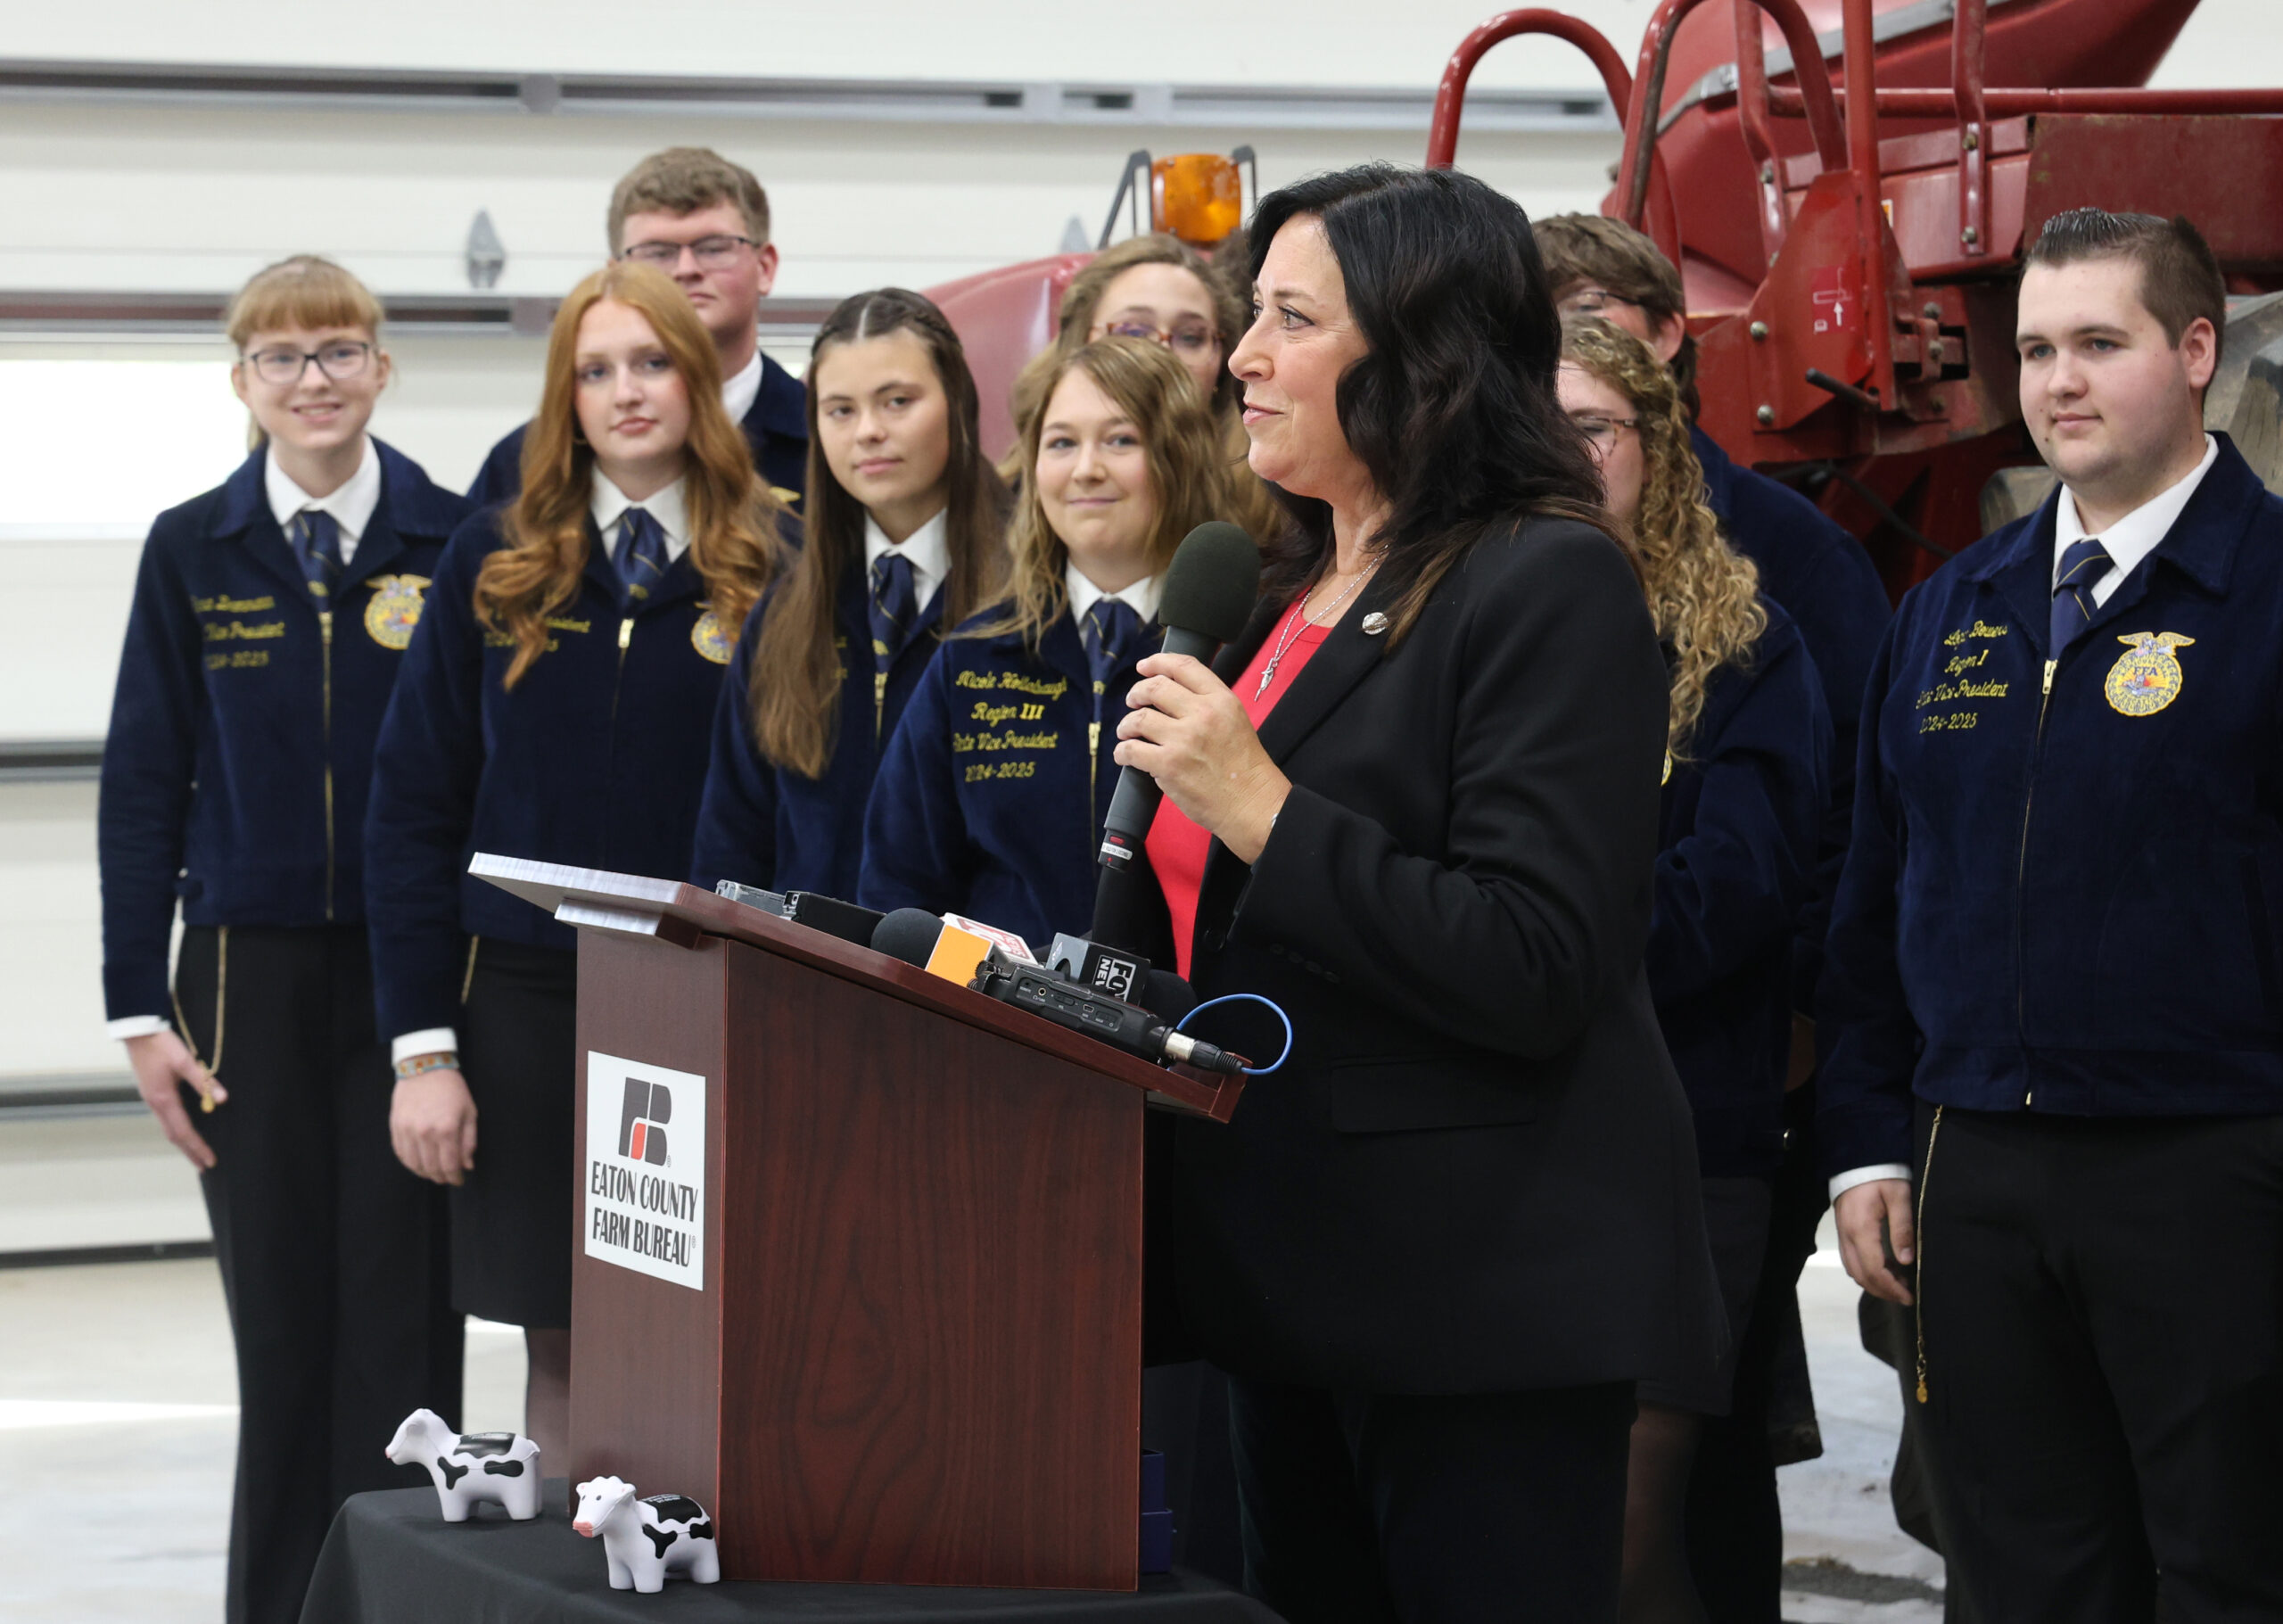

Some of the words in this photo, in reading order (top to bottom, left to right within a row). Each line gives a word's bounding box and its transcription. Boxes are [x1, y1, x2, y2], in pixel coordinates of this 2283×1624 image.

[971, 702, 1017, 727] Region
[1019, 703, 1045, 720] III
[1001, 730, 1059, 748] President
[591, 1160, 637, 1206] EATON
[640, 1175, 698, 1223] COUNTY
[592, 1207, 631, 1249] FARM
[633, 1218, 691, 1267] BUREAU
